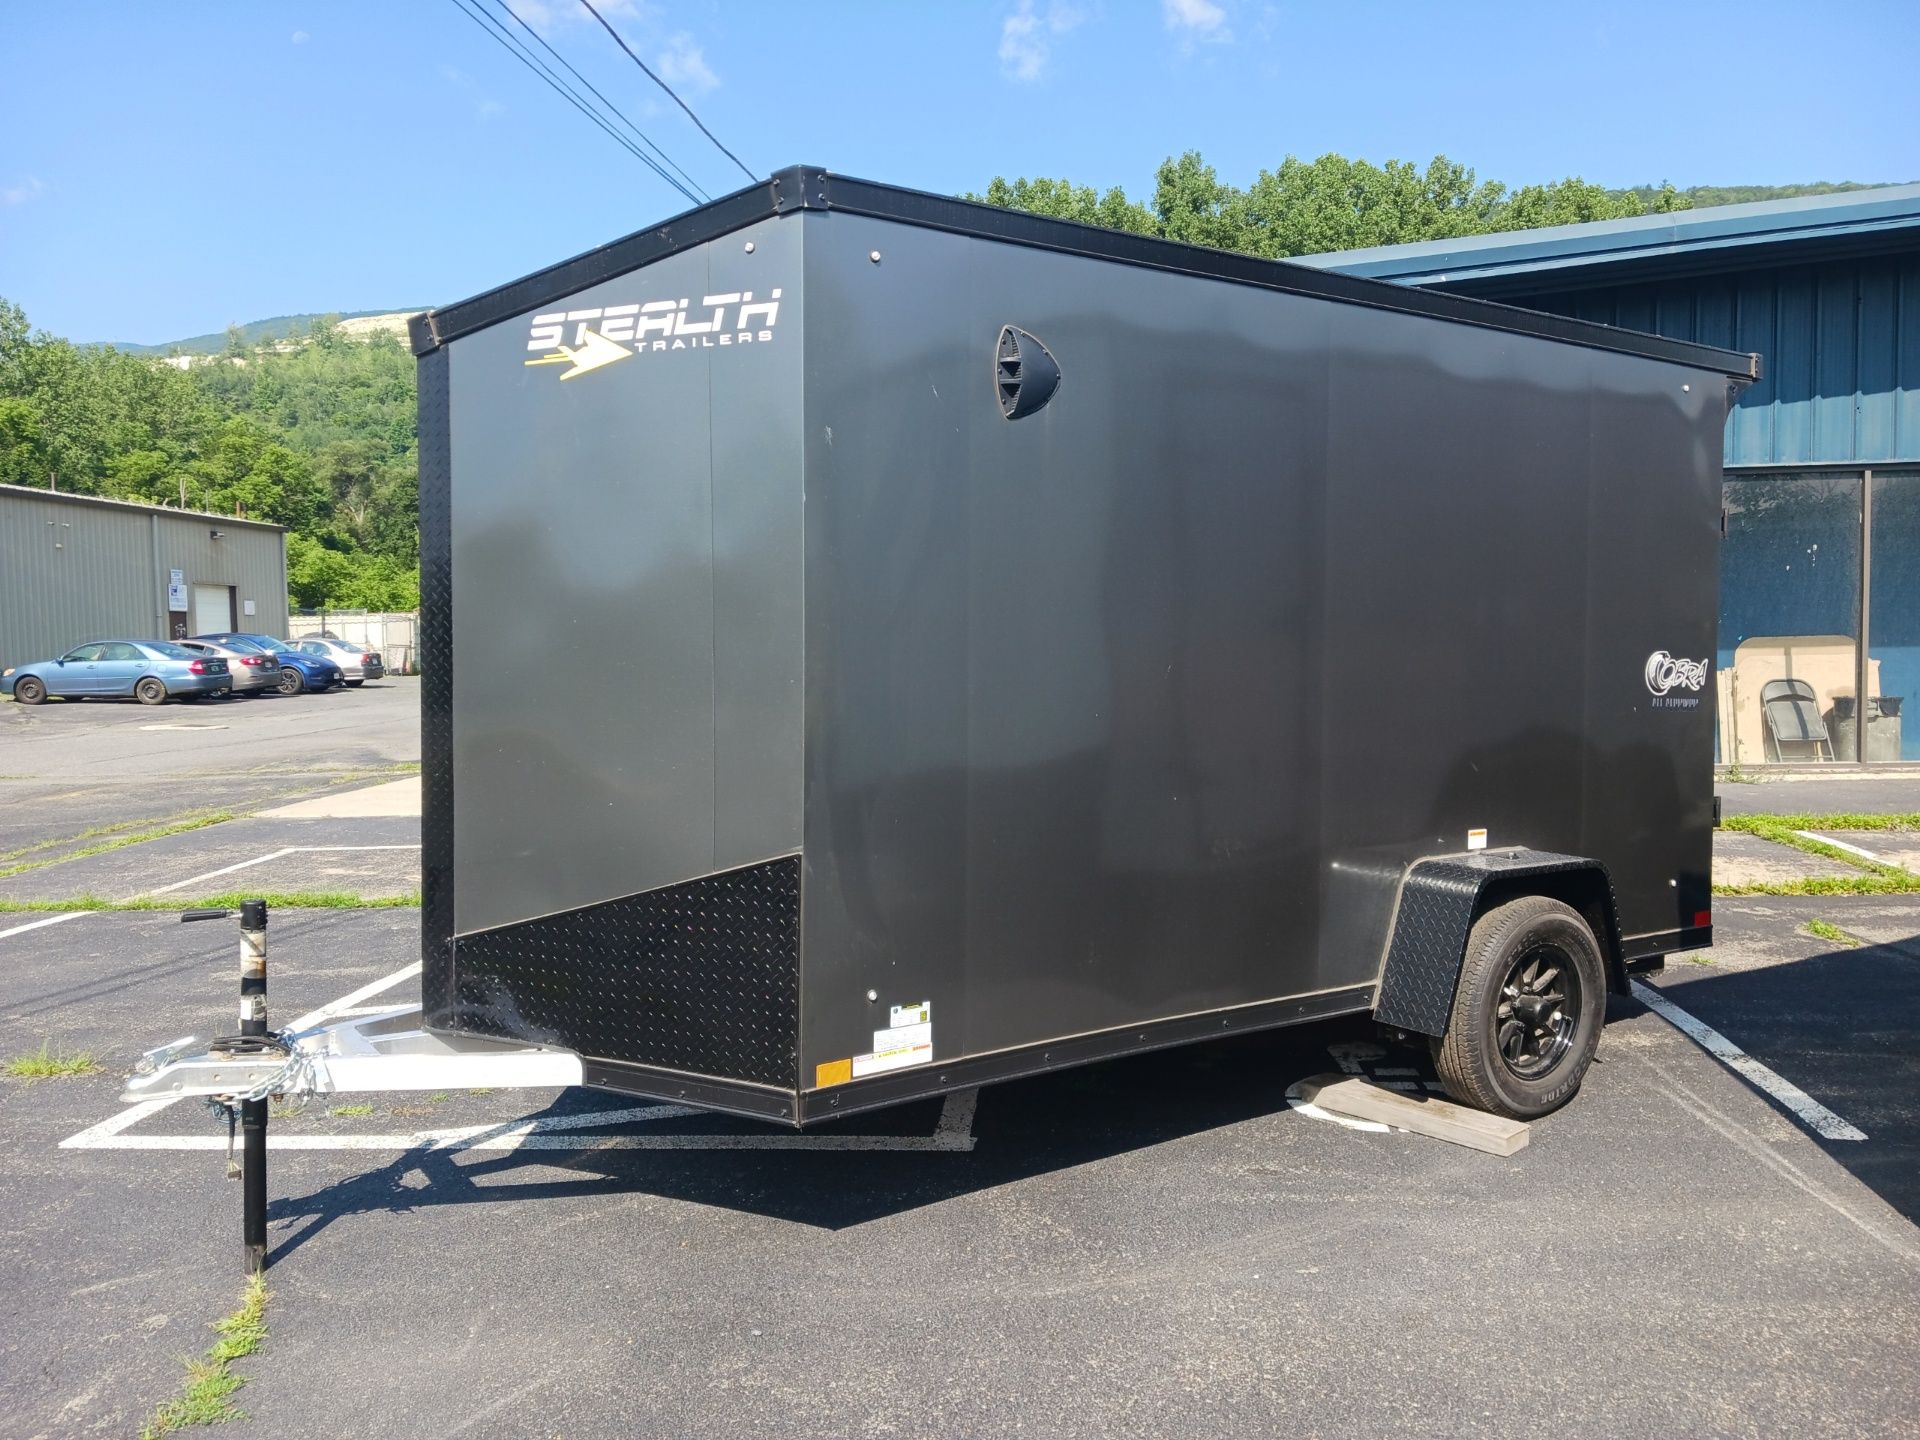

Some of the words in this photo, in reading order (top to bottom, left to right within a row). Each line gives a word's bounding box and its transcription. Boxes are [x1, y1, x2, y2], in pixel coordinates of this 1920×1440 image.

[527, 288, 782, 350] STEALTH
[634, 330, 773, 353] TRAILERS
[1645, 650, 1709, 696] COBRA
